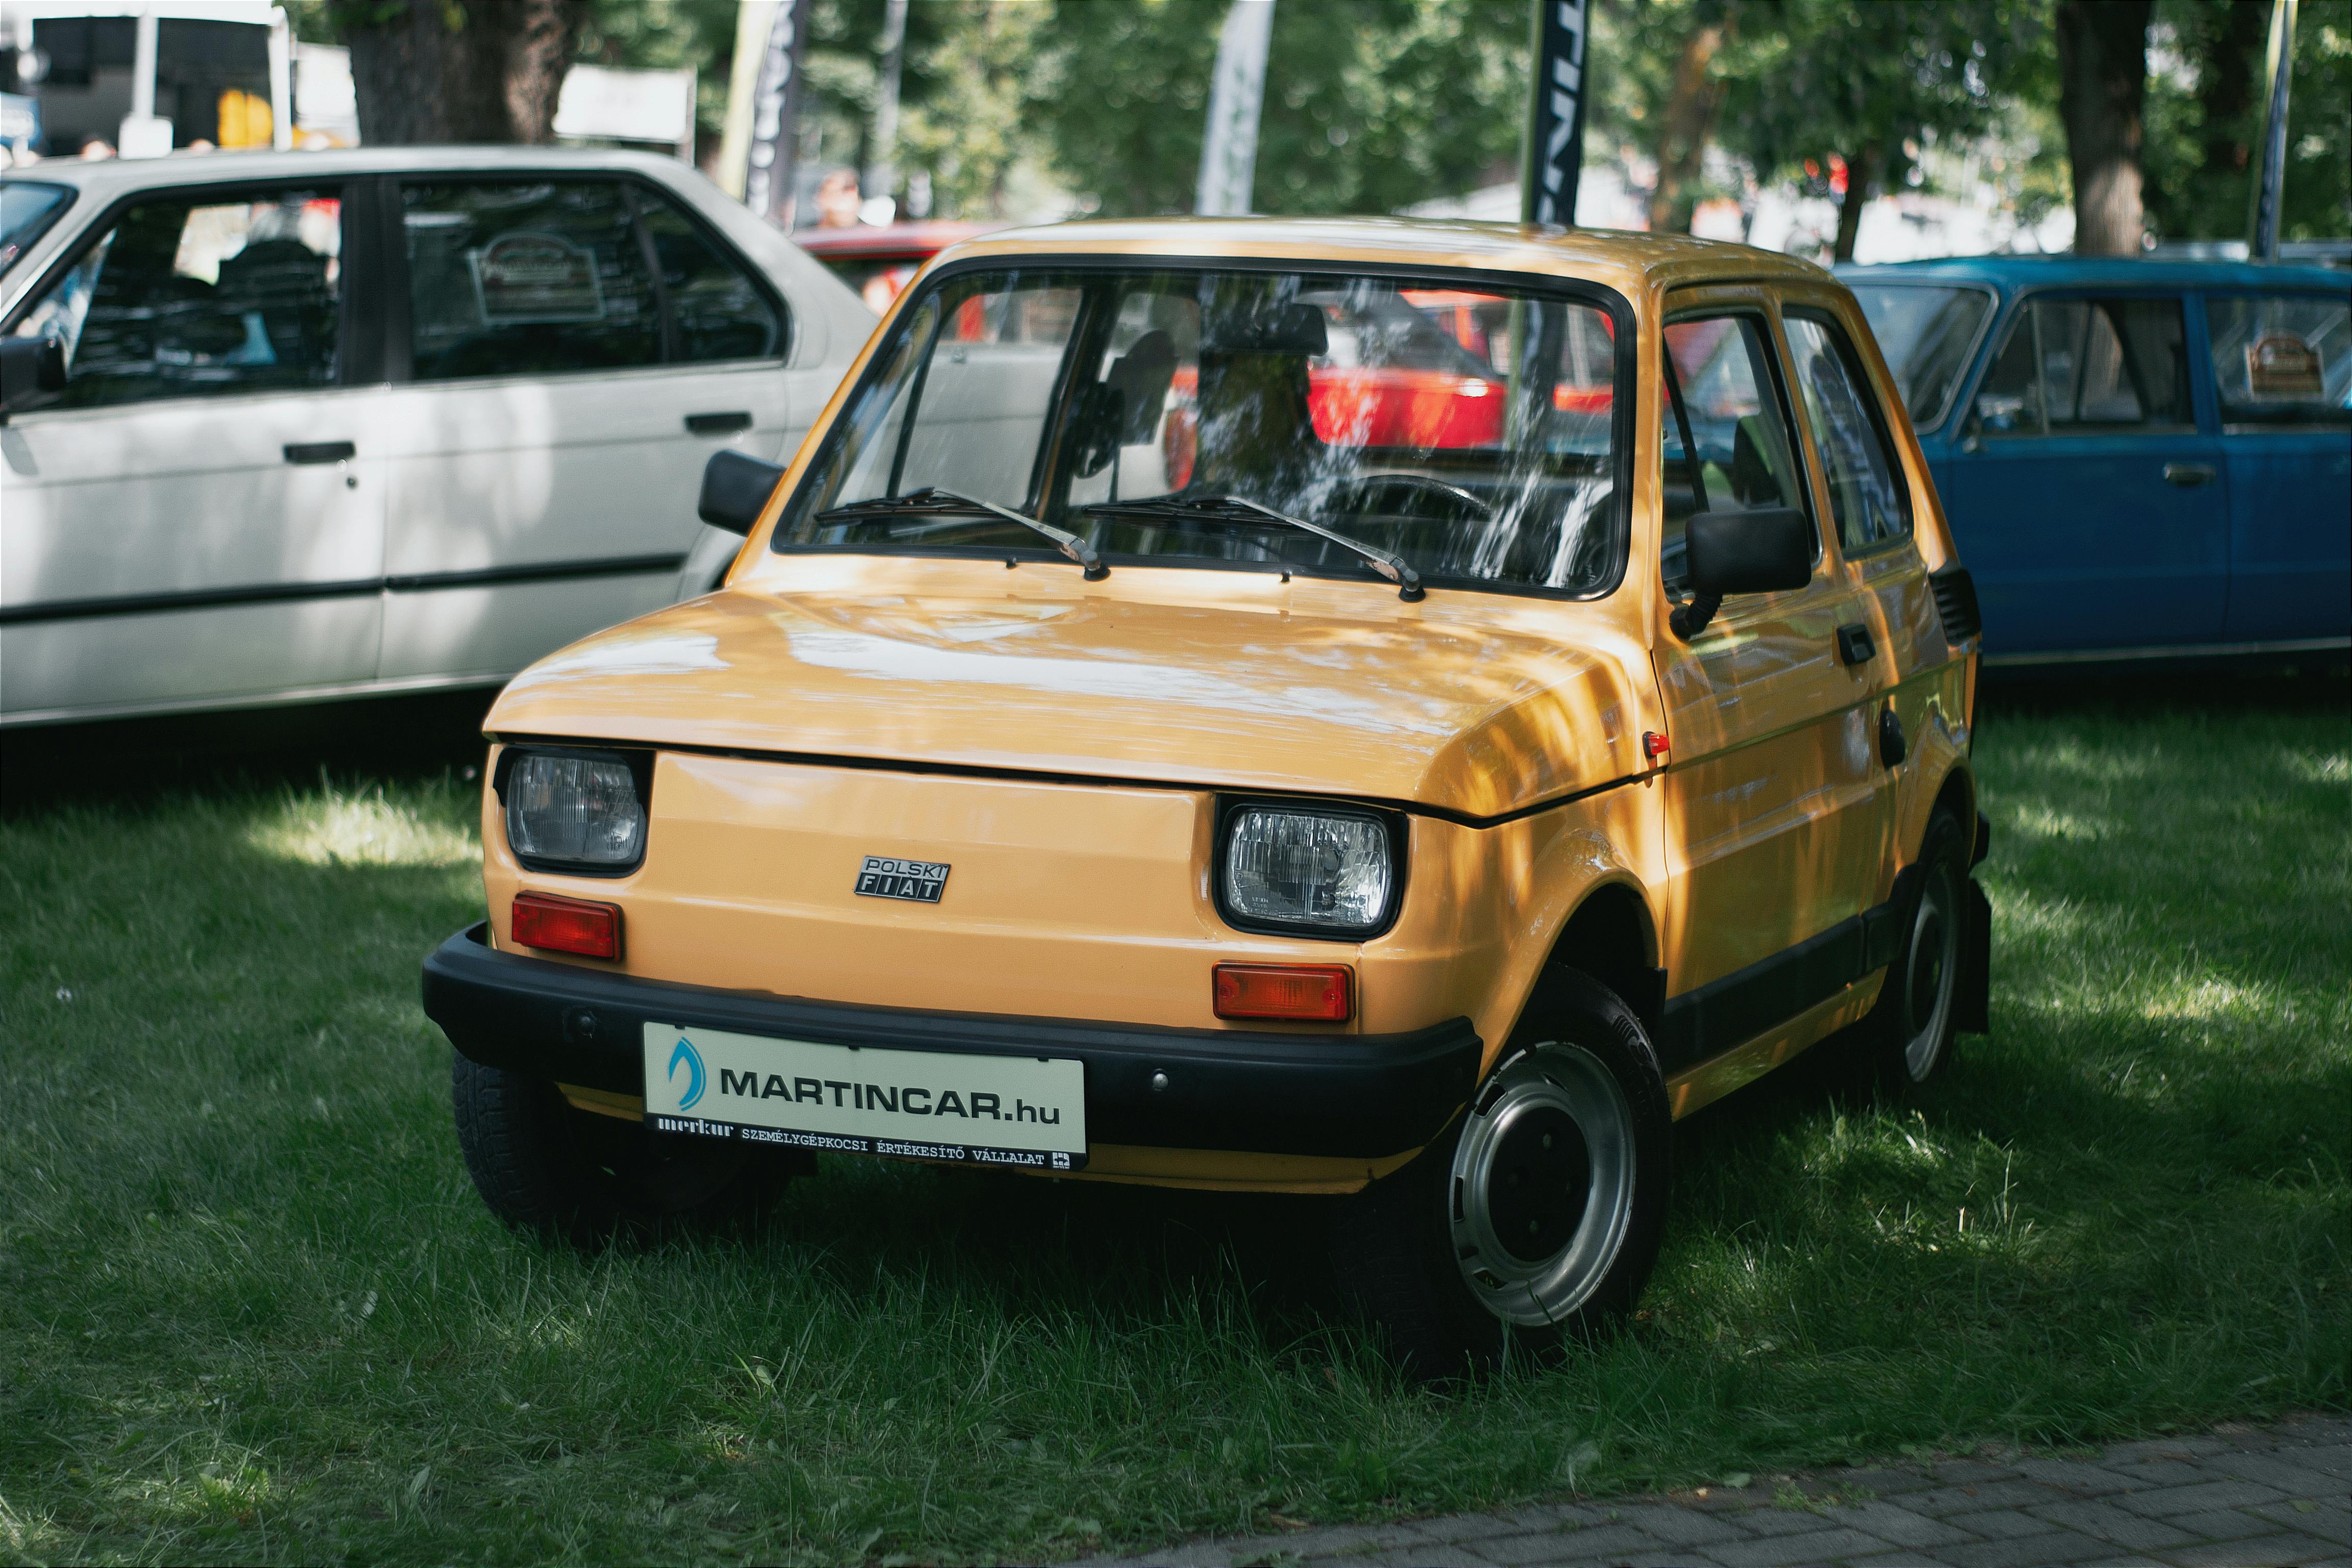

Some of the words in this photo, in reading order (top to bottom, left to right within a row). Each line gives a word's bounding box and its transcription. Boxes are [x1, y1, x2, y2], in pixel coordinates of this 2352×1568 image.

[865, 859, 943, 878] POLSKI
[861, 875, 938, 897] FIAT
[720, 1068, 1060, 1124] MARTINCAR.hu
[658, 1118, 734, 1137] merkur
[742, 1129, 868, 1151] SZEMÉLYGÉPKOCSI
[876, 1140, 965, 1160] ÉRTÉKESÍTŐ
[972, 1148, 1044, 1165] VÁLLALAT
